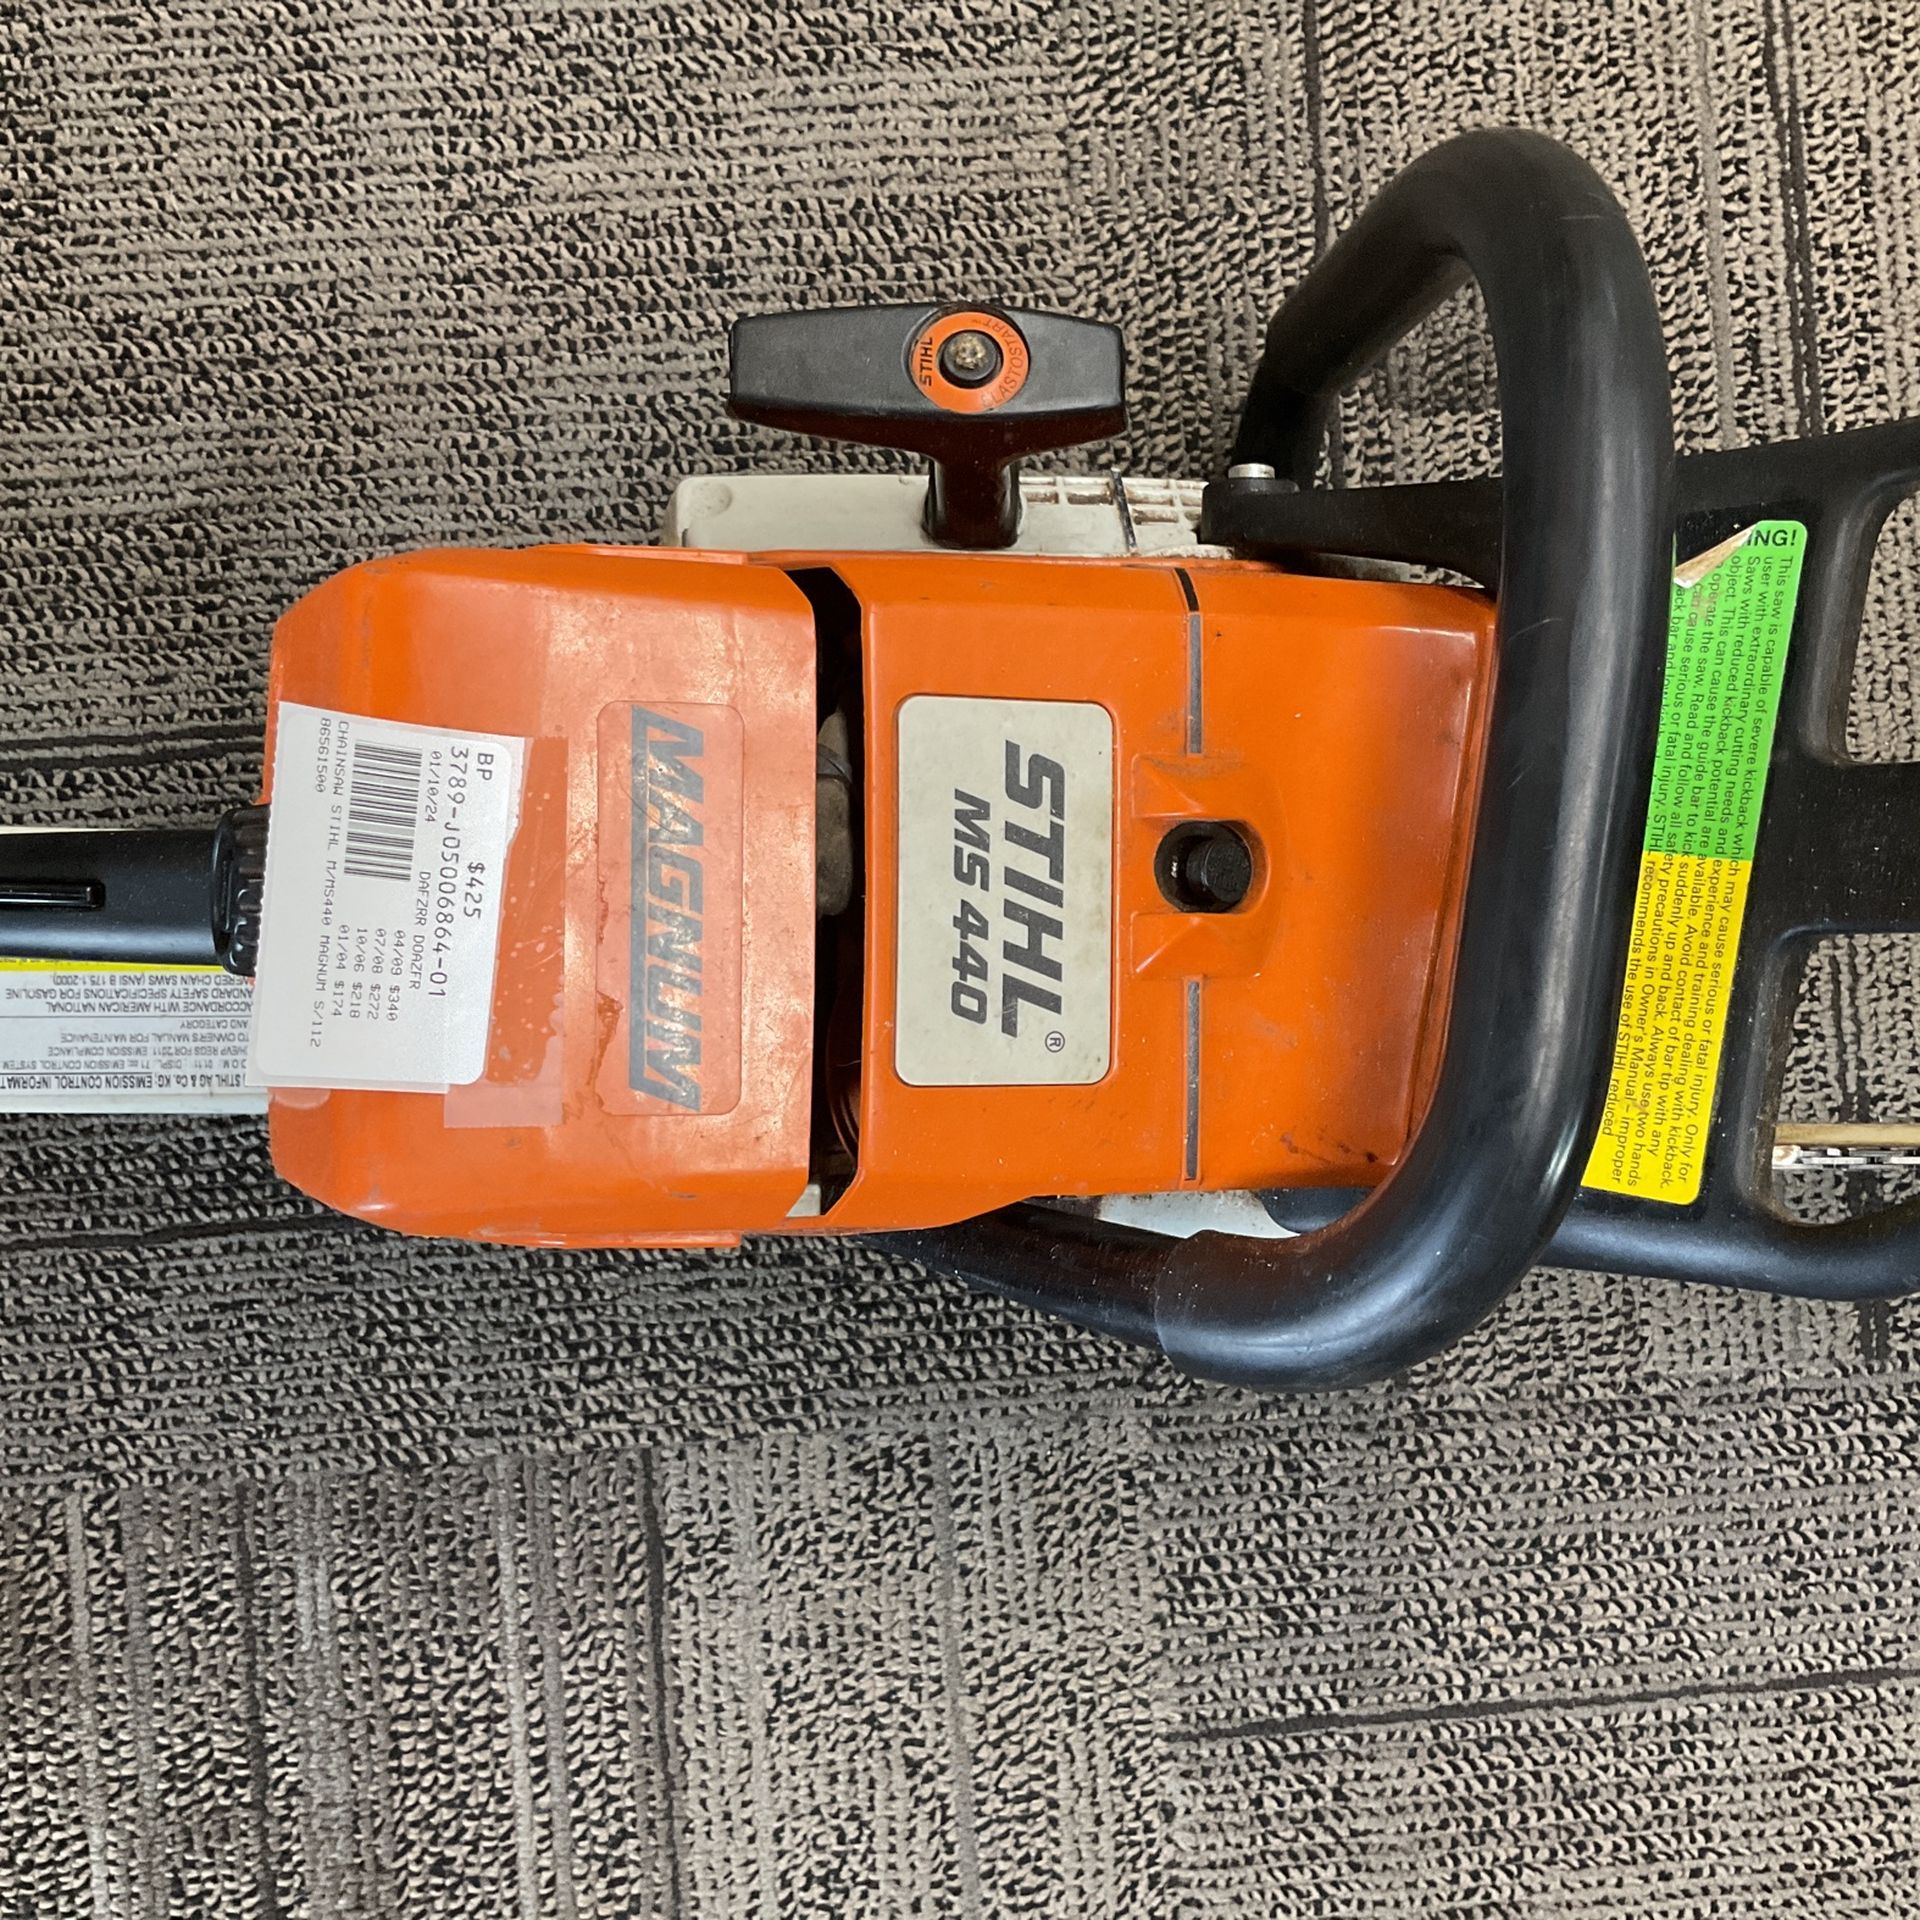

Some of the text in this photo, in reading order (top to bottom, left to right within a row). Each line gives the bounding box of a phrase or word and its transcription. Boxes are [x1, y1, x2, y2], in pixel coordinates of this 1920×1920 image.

[918, 336, 933, 386] STIHL
[1742, 555, 1759, 594] Saws
[1760, 556, 1772, 586] user
[1776, 555, 1792, 586] This
[1736, 598, 1749, 629] with
[1754, 591, 1766, 622] with
[1771, 590, 1784, 618] saw
[1683, 612, 1698, 652] cause
[1719, 605, 1735, 637] This
[1768, 623, 1780, 636] is
[1699, 630, 1714, 653] the
[1714, 640, 1726, 666] can
[1725, 634, 1744, 692] reduced
[1734, 626, 1761, 723] extraordinary
[1758, 638, 1775, 695] capable
[1673, 656, 1690, 708] serious
[1706, 670, 1721, 711] cause
[1670, 711, 1681, 727] or
[1686, 693, 1703, 729] Read
[1755, 699, 1766, 714] of
[1701, 714, 1716, 737] the
[1715, 695, 1736, 756] kickback
[1746, 717, 1762, 765] severe
[312, 717, 333, 793] 86561500
[1664, 731, 1680, 761] fatal
[1681, 733, 1693, 760] and
[1693, 741, 1708, 782] guide
[1725, 726, 1744, 776] cutting
[423, 750, 443, 823] 01/10/24
[1673, 763, 1690, 808] follow
[1689, 785, 1703, 808] bar
[1704, 758, 1722, 822] potential
[1735, 769, 1756, 830] kickback
[1720, 780, 1735, 824] needs
[461, 751, 494, 919] BP $425
[1648, 813, 1666, 857] STIHL
[1669, 812, 1681, 828] all
[1686, 812, 1699, 827] to
[1658, 832, 1676, 874] safety
[1681, 831, 1696, 858] kick
[1699, 825, 1711, 849] are
[1715, 828, 1727, 855] and
[1728, 832, 1743, 877] which
[308, 720, 351, 1048] CHAINSAW STIHL M/MS440 MAGNUM S/112
[413, 870, 431, 925] DAFZRR
[1001, 739, 1066, 1038] STIHL
[1667, 861, 1688, 927] suddenly
[1701, 858, 1722, 938] experience
[1718, 880, 1735, 912] may
[630, 705, 703, 1111] MAGNUM
[950, 788, 991, 1025] MS 440
[1631, 861, 1655, 955] recommends
[1647, 878, 1669, 962] precautions
[1663, 931, 1676, 949] up
[1680, 924, 1697, 966] Avoid
[1714, 916, 1729, 958] cause
[330, 924, 351, 1017] 01/04 $174
[1627, 958, 1641, 980] the
[1661, 953, 1673, 981] and
[1696, 941, 1708, 969] and
[148, 975, 177, 985] SAWS
[180, 975, 211, 985] CHAIN
[347, 927, 369, 1019] 10/06 $218
[366, 928, 388, 1020] 07/08 $272
[385, 929, 406, 1021] 04/09 $340
[1644, 966, 1657, 979] in
[1704, 962, 1721, 1015] serious
[5, 988, 252, 999] ANDARD SAFETY SPECIFICATIONS FOR GASOLINE
[45, 1001, 95, 1012] NATIONAL
[98, 1001, 150, 1012] AMERICAN
[154, 1001, 179, 1011] WITH
[1623, 984, 1634, 1009] use
[1671, 969, 1687, 1023] contact
[1683, 973, 1706, 1028] training
[1619, 1013, 1630, 1029] of
[1633, 983, 1654, 1042] Owner's
[1702, 1019, 1712, 1034] or
[1667, 1026, 1678, 1041] of
[1643, 1025, 1664, 1078] Always
[1663, 1045, 1677, 1067] bar
[1674, 1032, 1696, 1086] dealing
[1696, 1038, 1711, 1069] fatal
[54, 1075, 102, 1088] CONTROL
[105, 1075, 152, 1088] EMISSION
[190, 1074, 196, 1087] &
[199, 1074, 212, 1087] AG
[215, 1074, 240, 1087] STIHL
[1624, 1047, 1643, 1101] Manual
[1656, 1071, 1672, 1090] tip
[1601, 1078, 1619, 1136] reduced
[1639, 1082, 1651, 1107] use
[1653, 1094, 1666, 1126] with
[1671, 1089, 1684, 1121] with
[1634, 1110, 1650, 1138] two
[1678, 1123, 1698, 1157] Only
[1609, 1115, 1631, 1182] improper
[1644, 1129, 1660, 1156] any
[1627, 1142, 1645, 1186] hands
[1677, 1161, 1691, 1182] for
